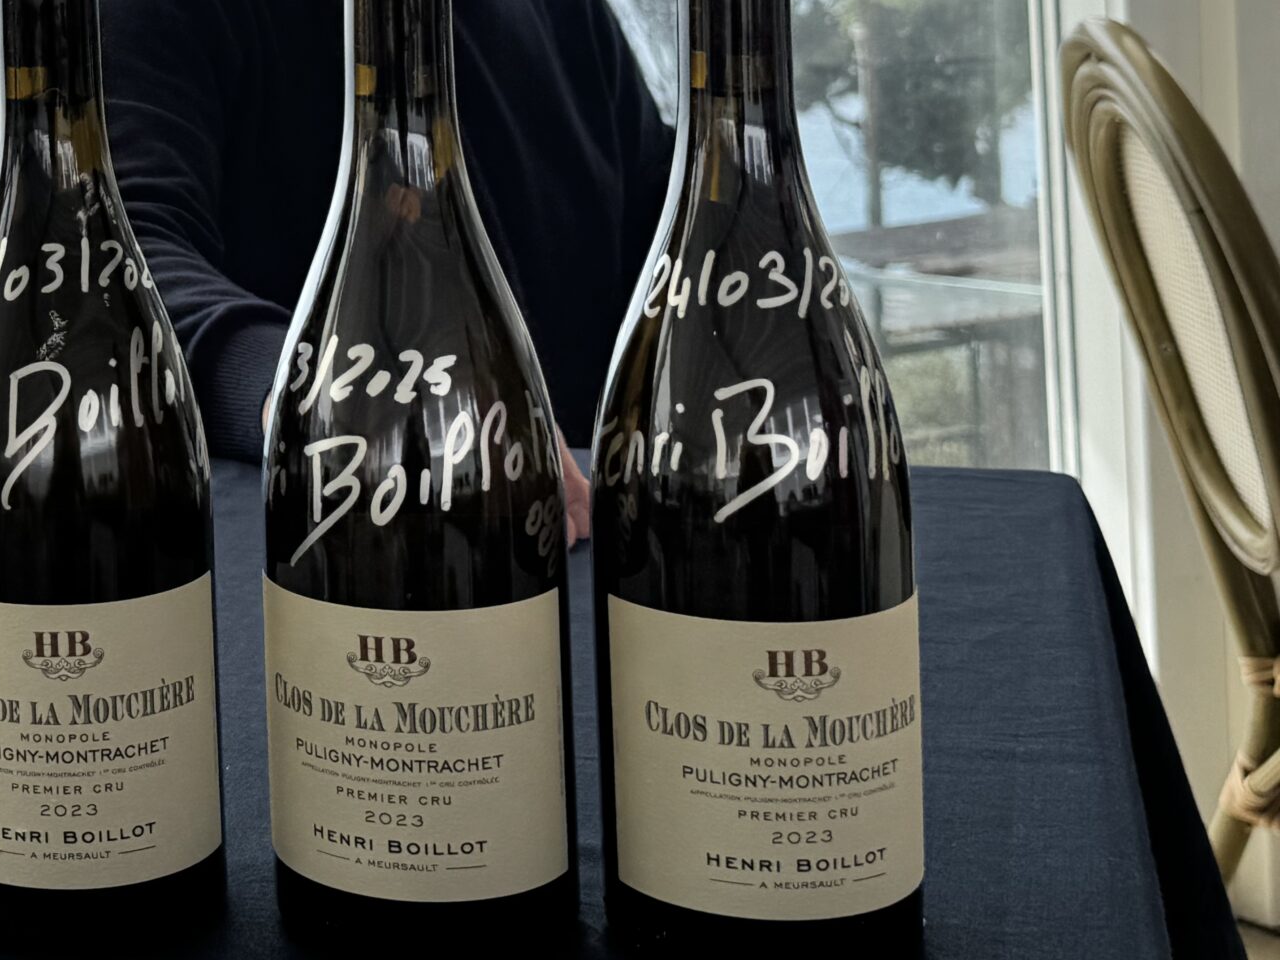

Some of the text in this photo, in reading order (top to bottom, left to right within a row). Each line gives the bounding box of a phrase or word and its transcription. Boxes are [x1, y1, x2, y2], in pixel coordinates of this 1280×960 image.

[32, 630, 92, 658] HB
[357, 634, 418, 665] HB
[765, 648, 829, 678] HB
[275, 672, 312, 717] CLOS
[319, 697, 346, 725] DE
[354, 704, 386, 732] LA
[30, 701, 61, 726] LA
[644, 700, 708, 743] CLOS
[717, 720, 751, 747] DE
[761, 724, 796, 749] LA
[20, 732, 111, 743] MONOPOLE
[345, 736, 438, 753] MONOPOLE
[296, 737, 504, 774] PULIGNY-MONTRACHET
[750, 754, 848, 768] MONOPOLE
[681, 757, 899, 790] PULIGNY-MONTRACHET
[11, 782, 124, 795] PREMIER CRU
[336, 786, 452, 806] PREMIER CRU
[40, 804, 98, 817] 2023
[365, 810, 424, 828] 2023
[738, 806, 859, 821] PREMIER CRU
[63, 821, 156, 844] BOILLOT
[313, 824, 488, 856] HENRI BOILLOT
[771, 830, 833, 845] 2023
[43, 851, 112, 860] MEURSAULT
[355, 857, 439, 872] A MEURSAULT
[706, 847, 887, 873] HENRI BOILLOT
[759, 878, 846, 890] A MEURSAULT
